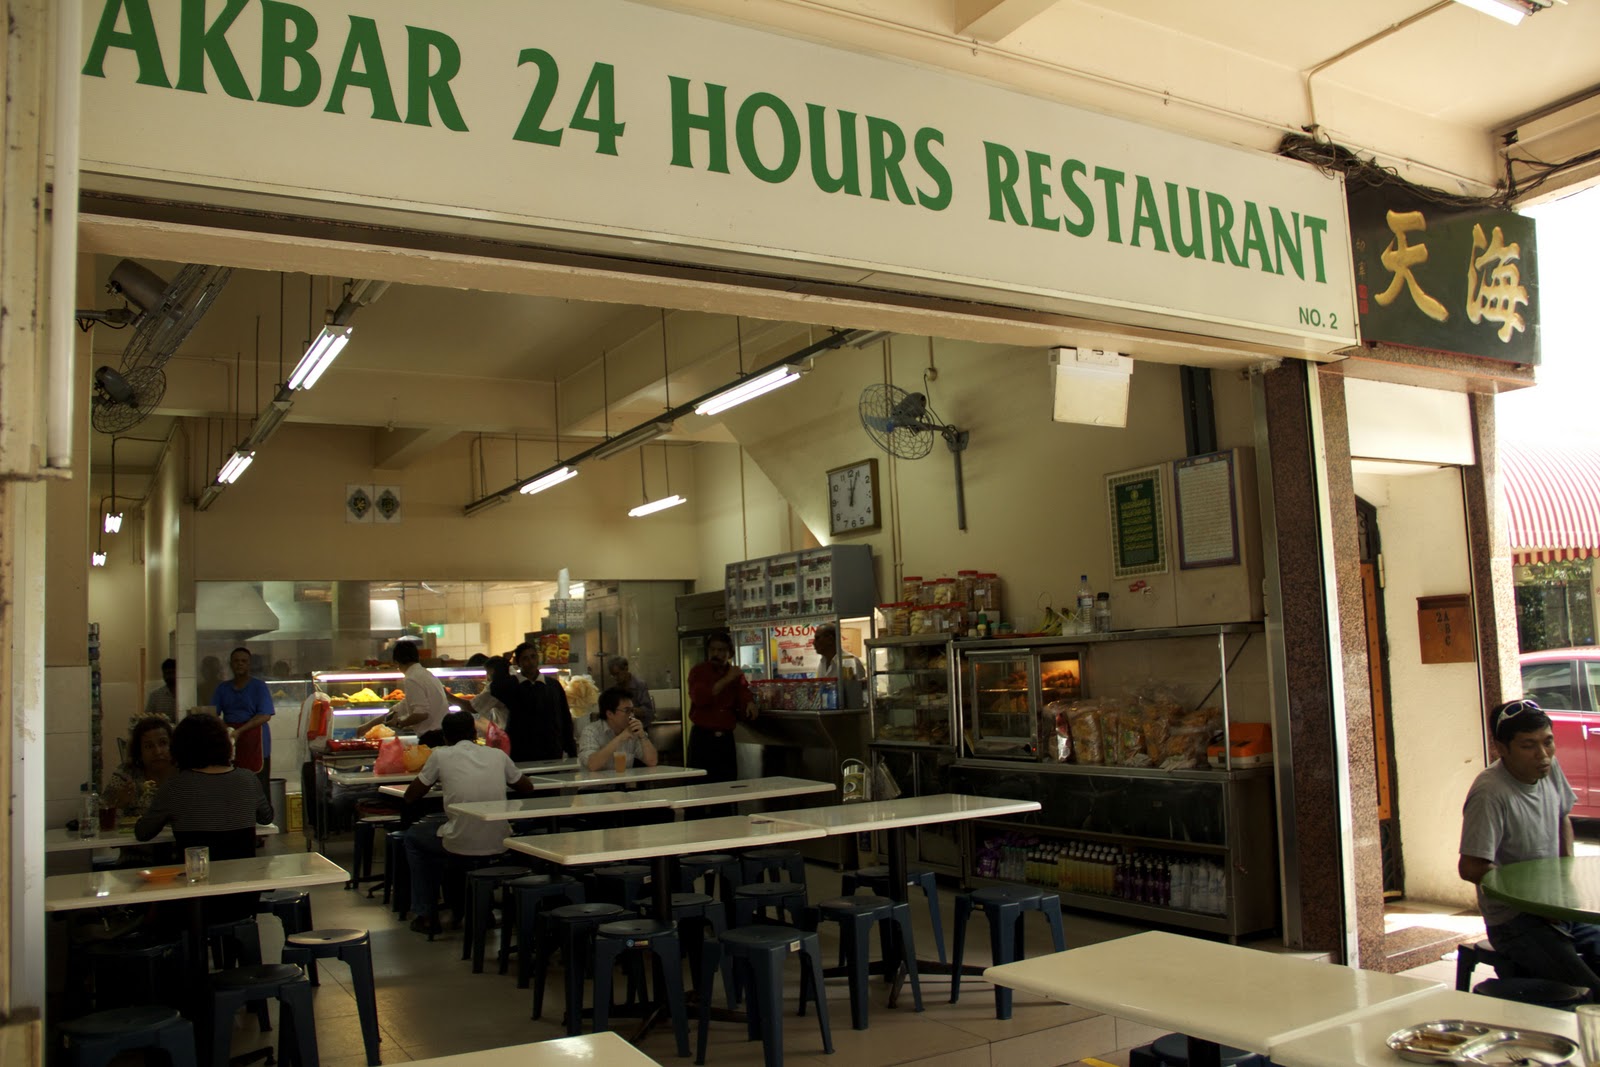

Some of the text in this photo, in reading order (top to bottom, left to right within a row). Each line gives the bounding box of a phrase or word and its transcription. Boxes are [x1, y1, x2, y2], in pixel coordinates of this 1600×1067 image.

[82, 0, 1328, 284] AKBAR 24 HOURS RESTAURANT
[1299, 306, 1338, 330] NO. 2
[847, 470, 853, 478] 12
[865, 475, 870, 483] 2
[833, 484, 838, 492] 10
